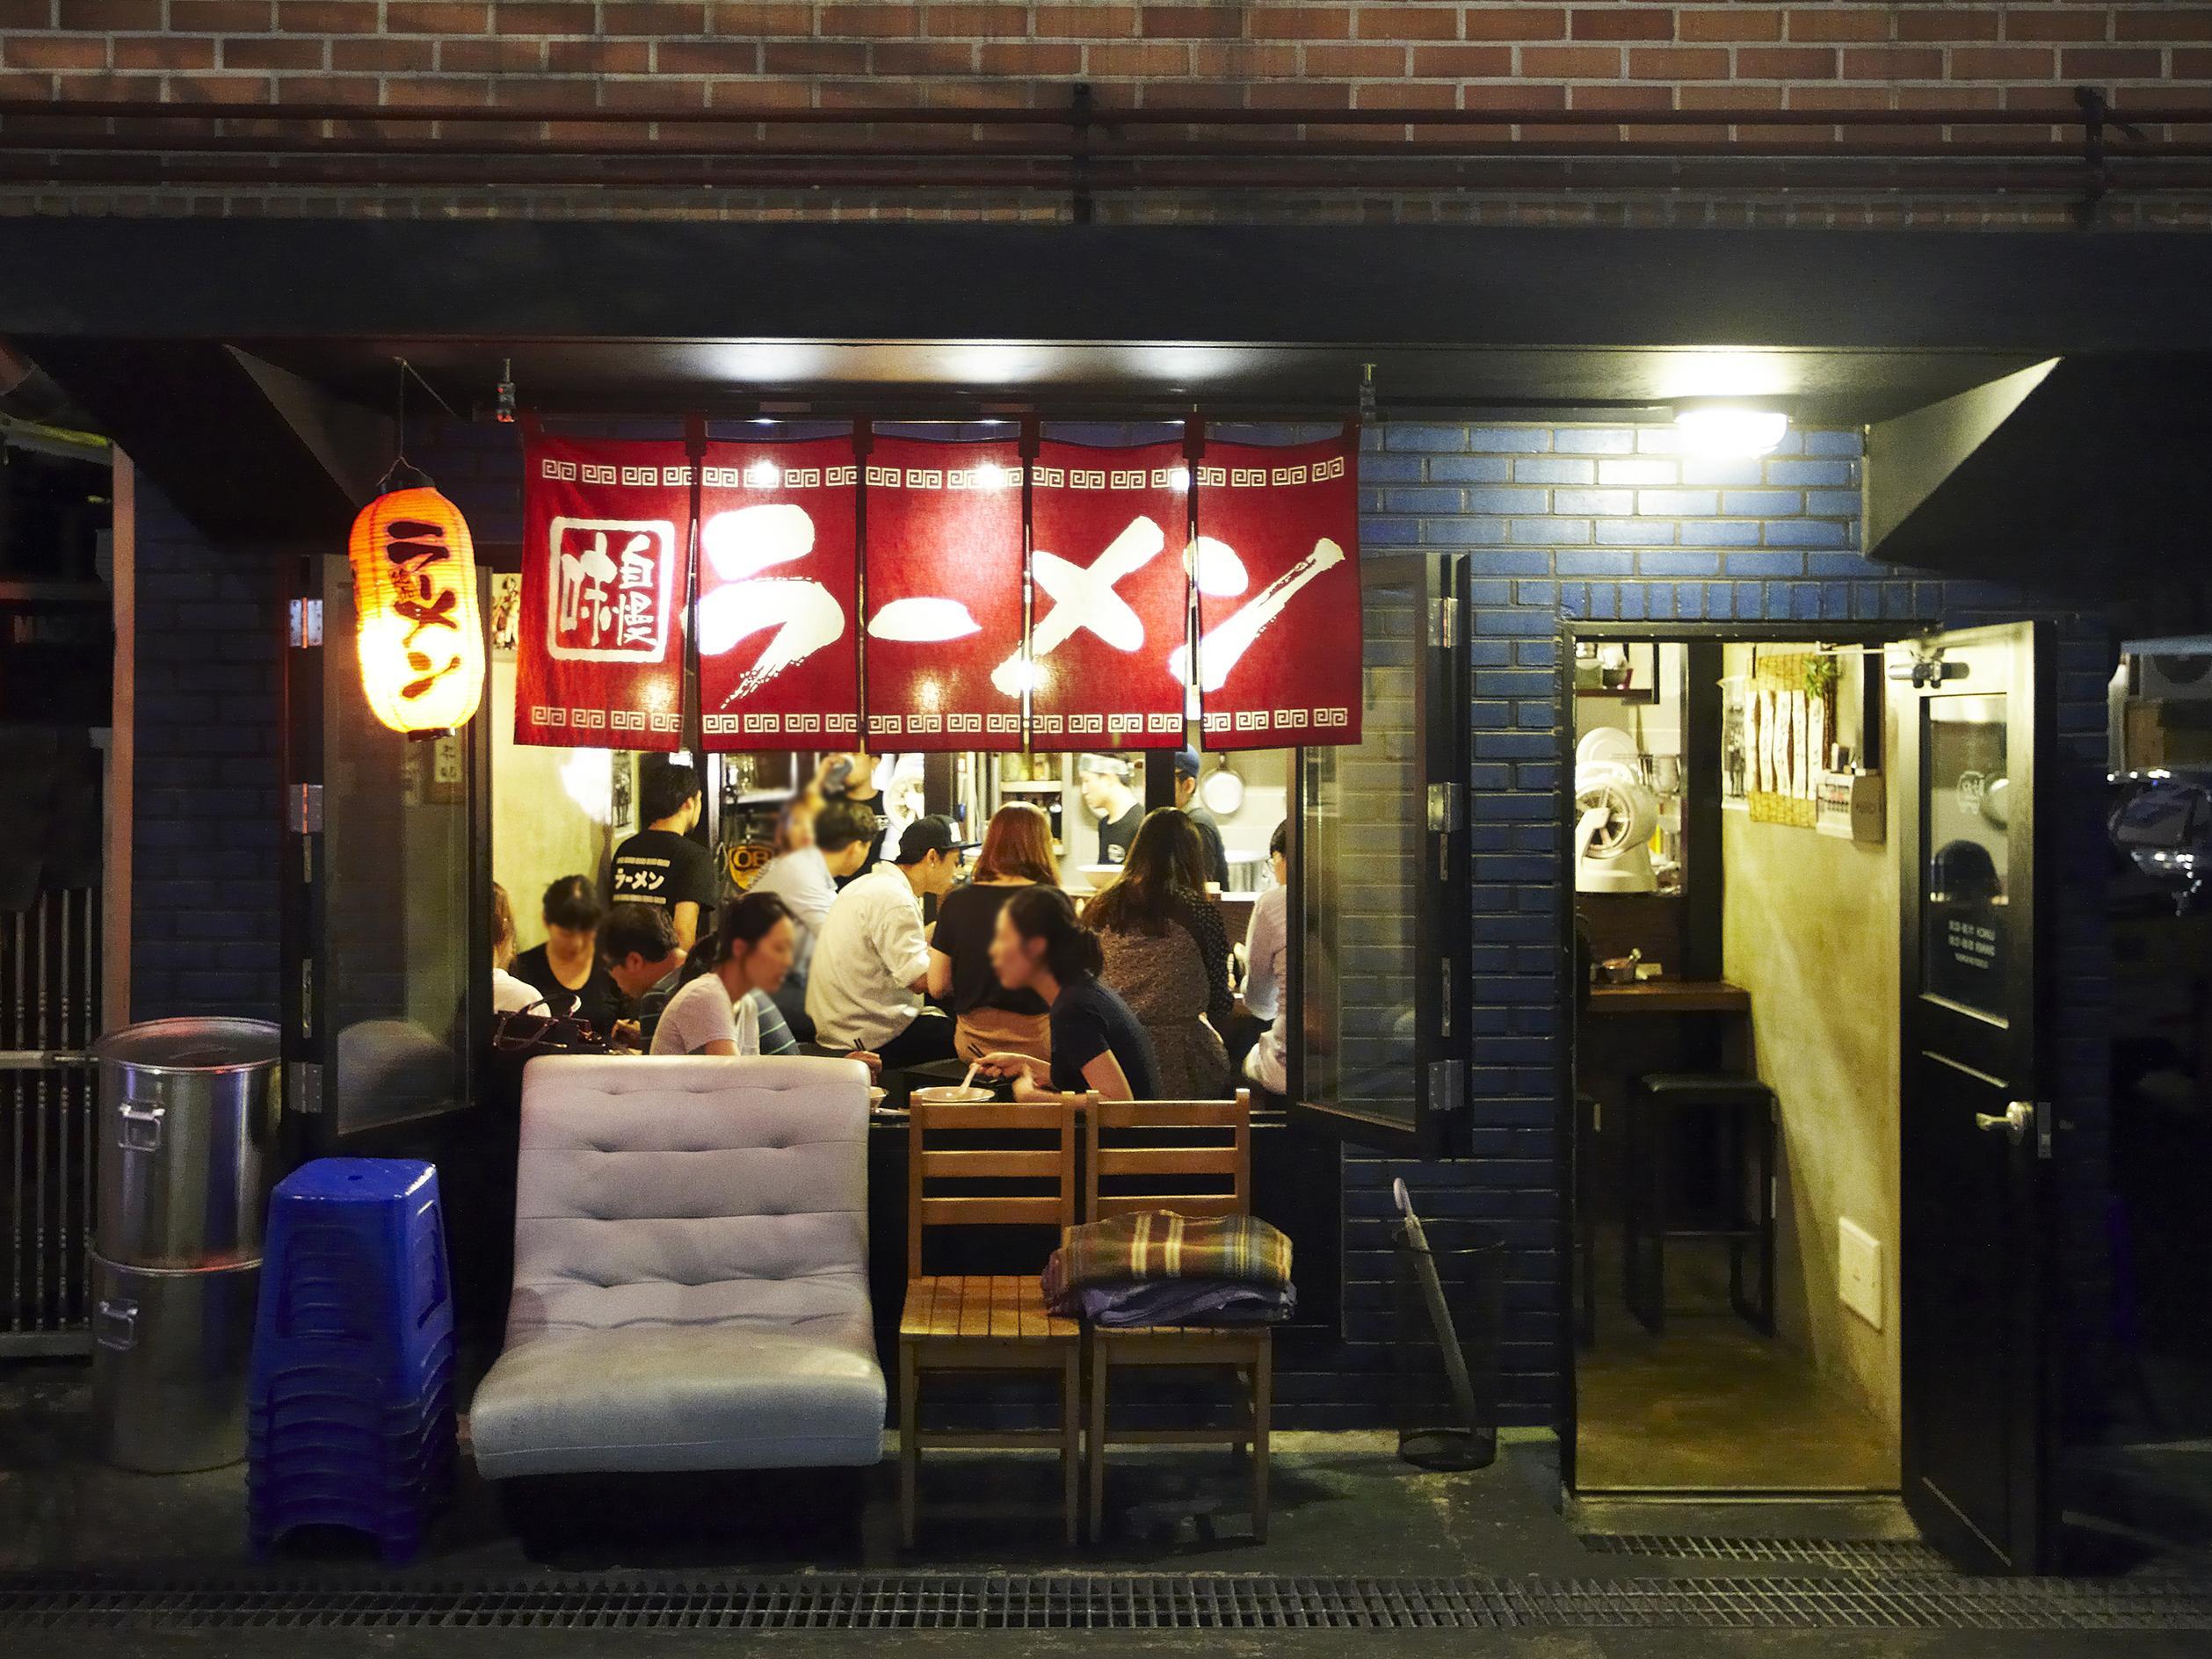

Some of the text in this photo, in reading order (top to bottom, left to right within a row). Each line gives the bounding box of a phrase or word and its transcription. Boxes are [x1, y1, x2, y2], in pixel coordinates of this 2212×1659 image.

[387, 521, 461, 698] ラーメン
[680, 503, 1345, 709] ラーメン
[615, 867, 664, 891] ラーメン
